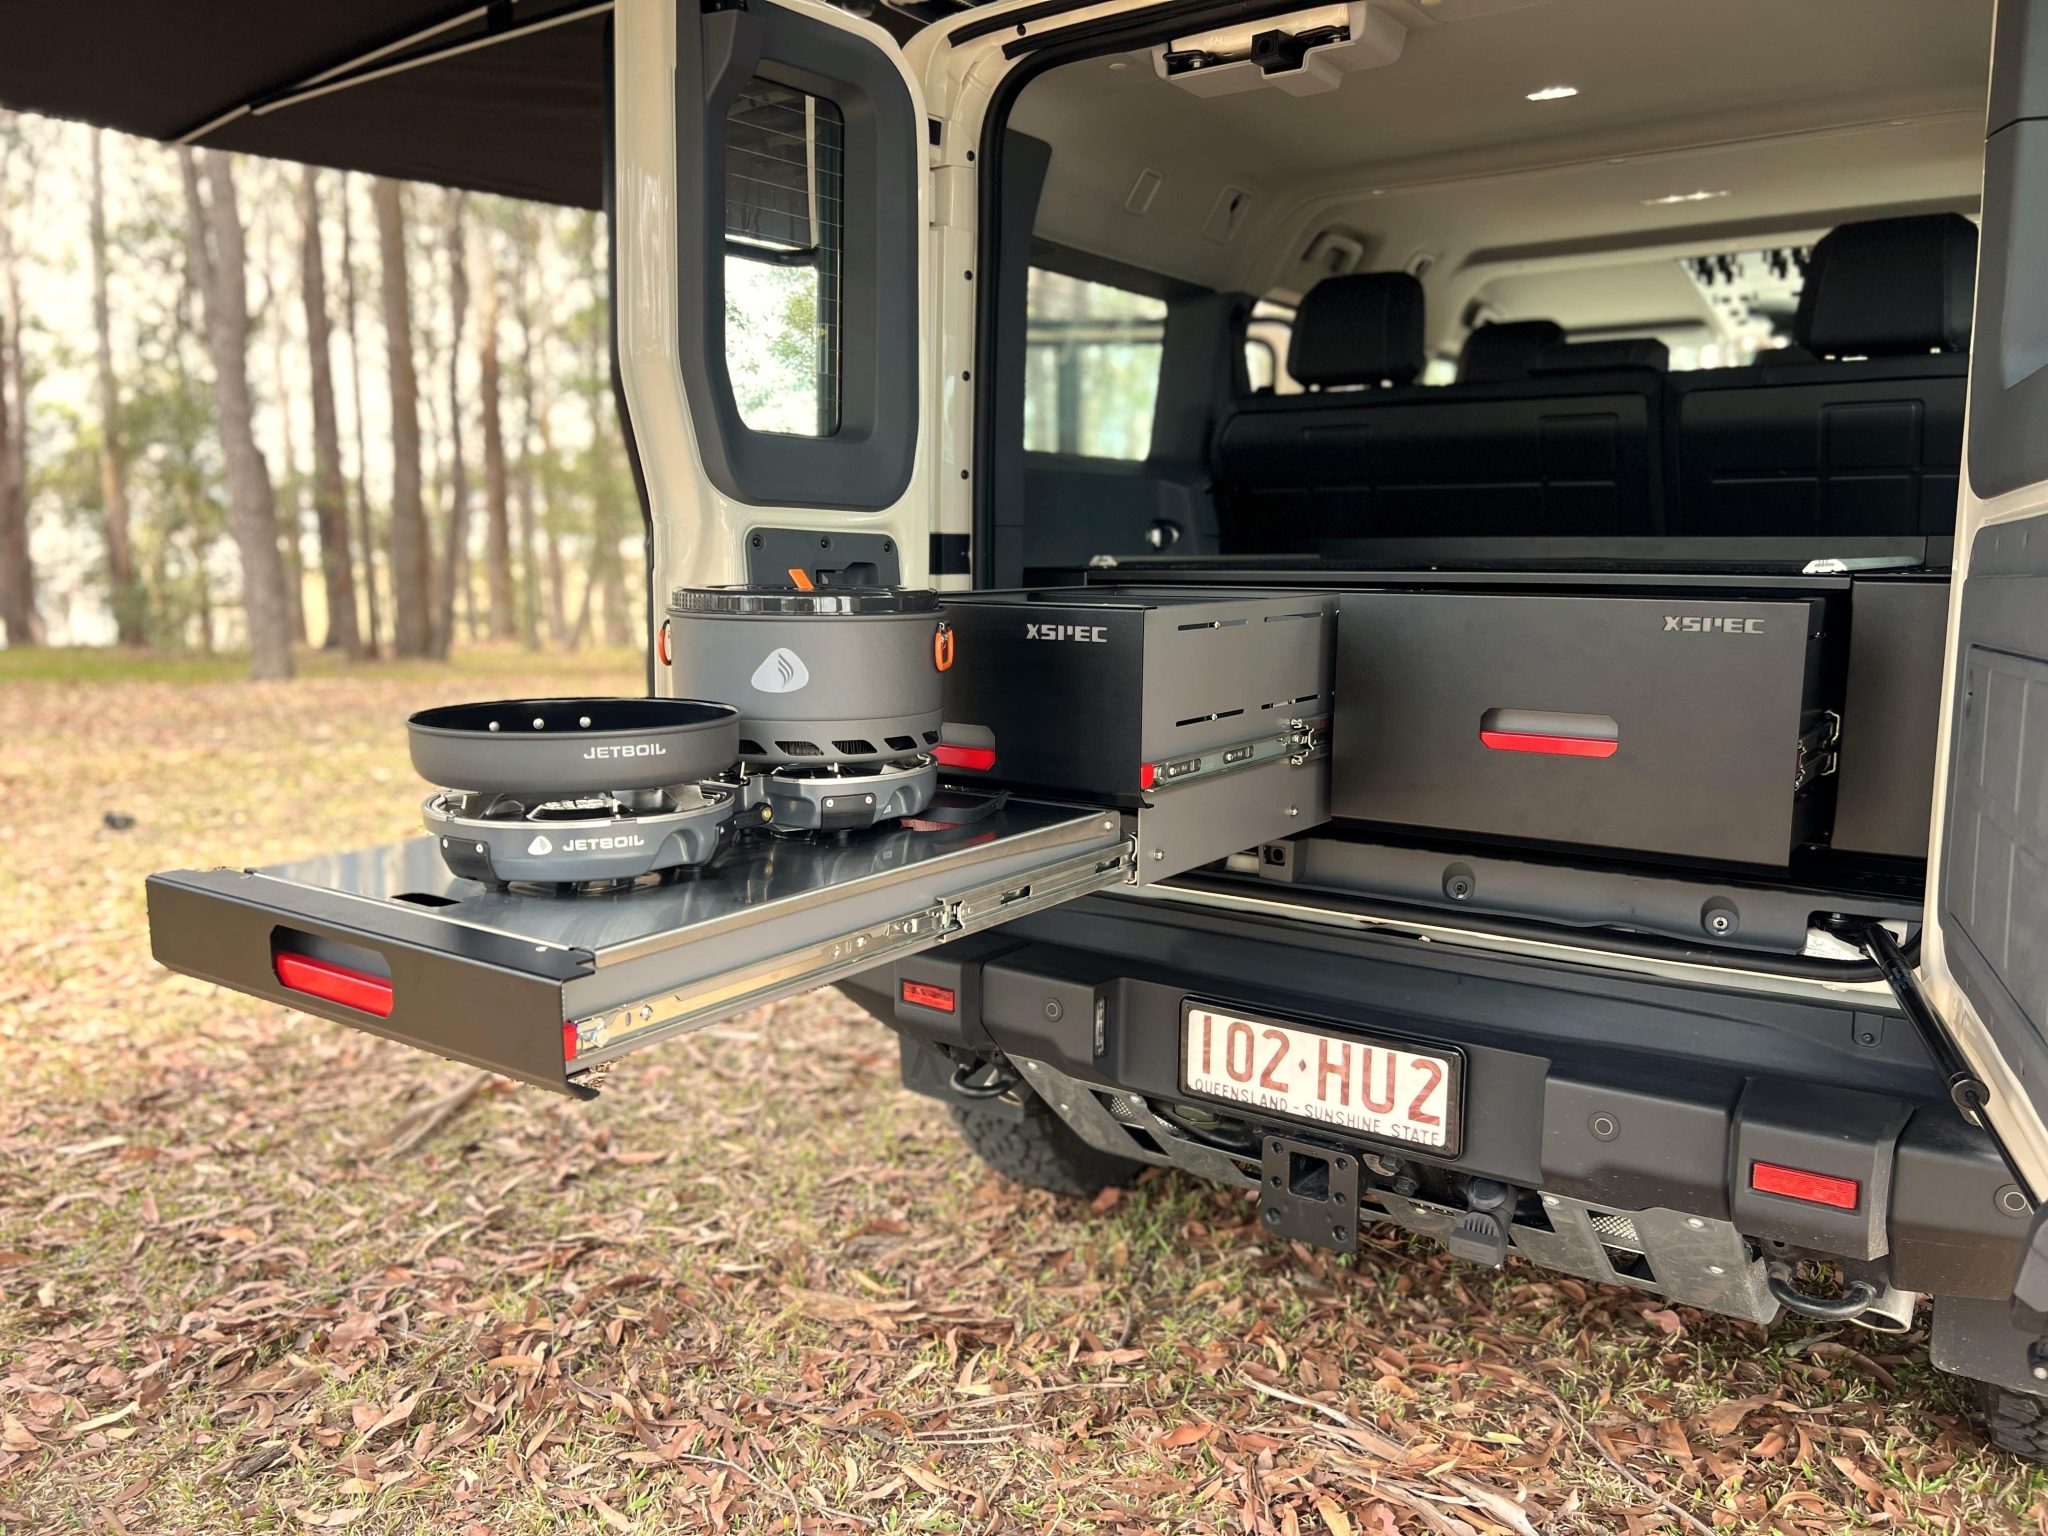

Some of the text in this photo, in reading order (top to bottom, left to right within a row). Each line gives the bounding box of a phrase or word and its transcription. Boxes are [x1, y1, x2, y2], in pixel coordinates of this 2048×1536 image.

[583, 743, 666, 759] JETBOIL
[562, 835, 645, 851] JETBOIL
[1195, 1078, 1288, 1112] QUEENSLAND
[1304, 1104, 1381, 1134] SUNSHINE
[1391, 1124, 1440, 1145] STATE
